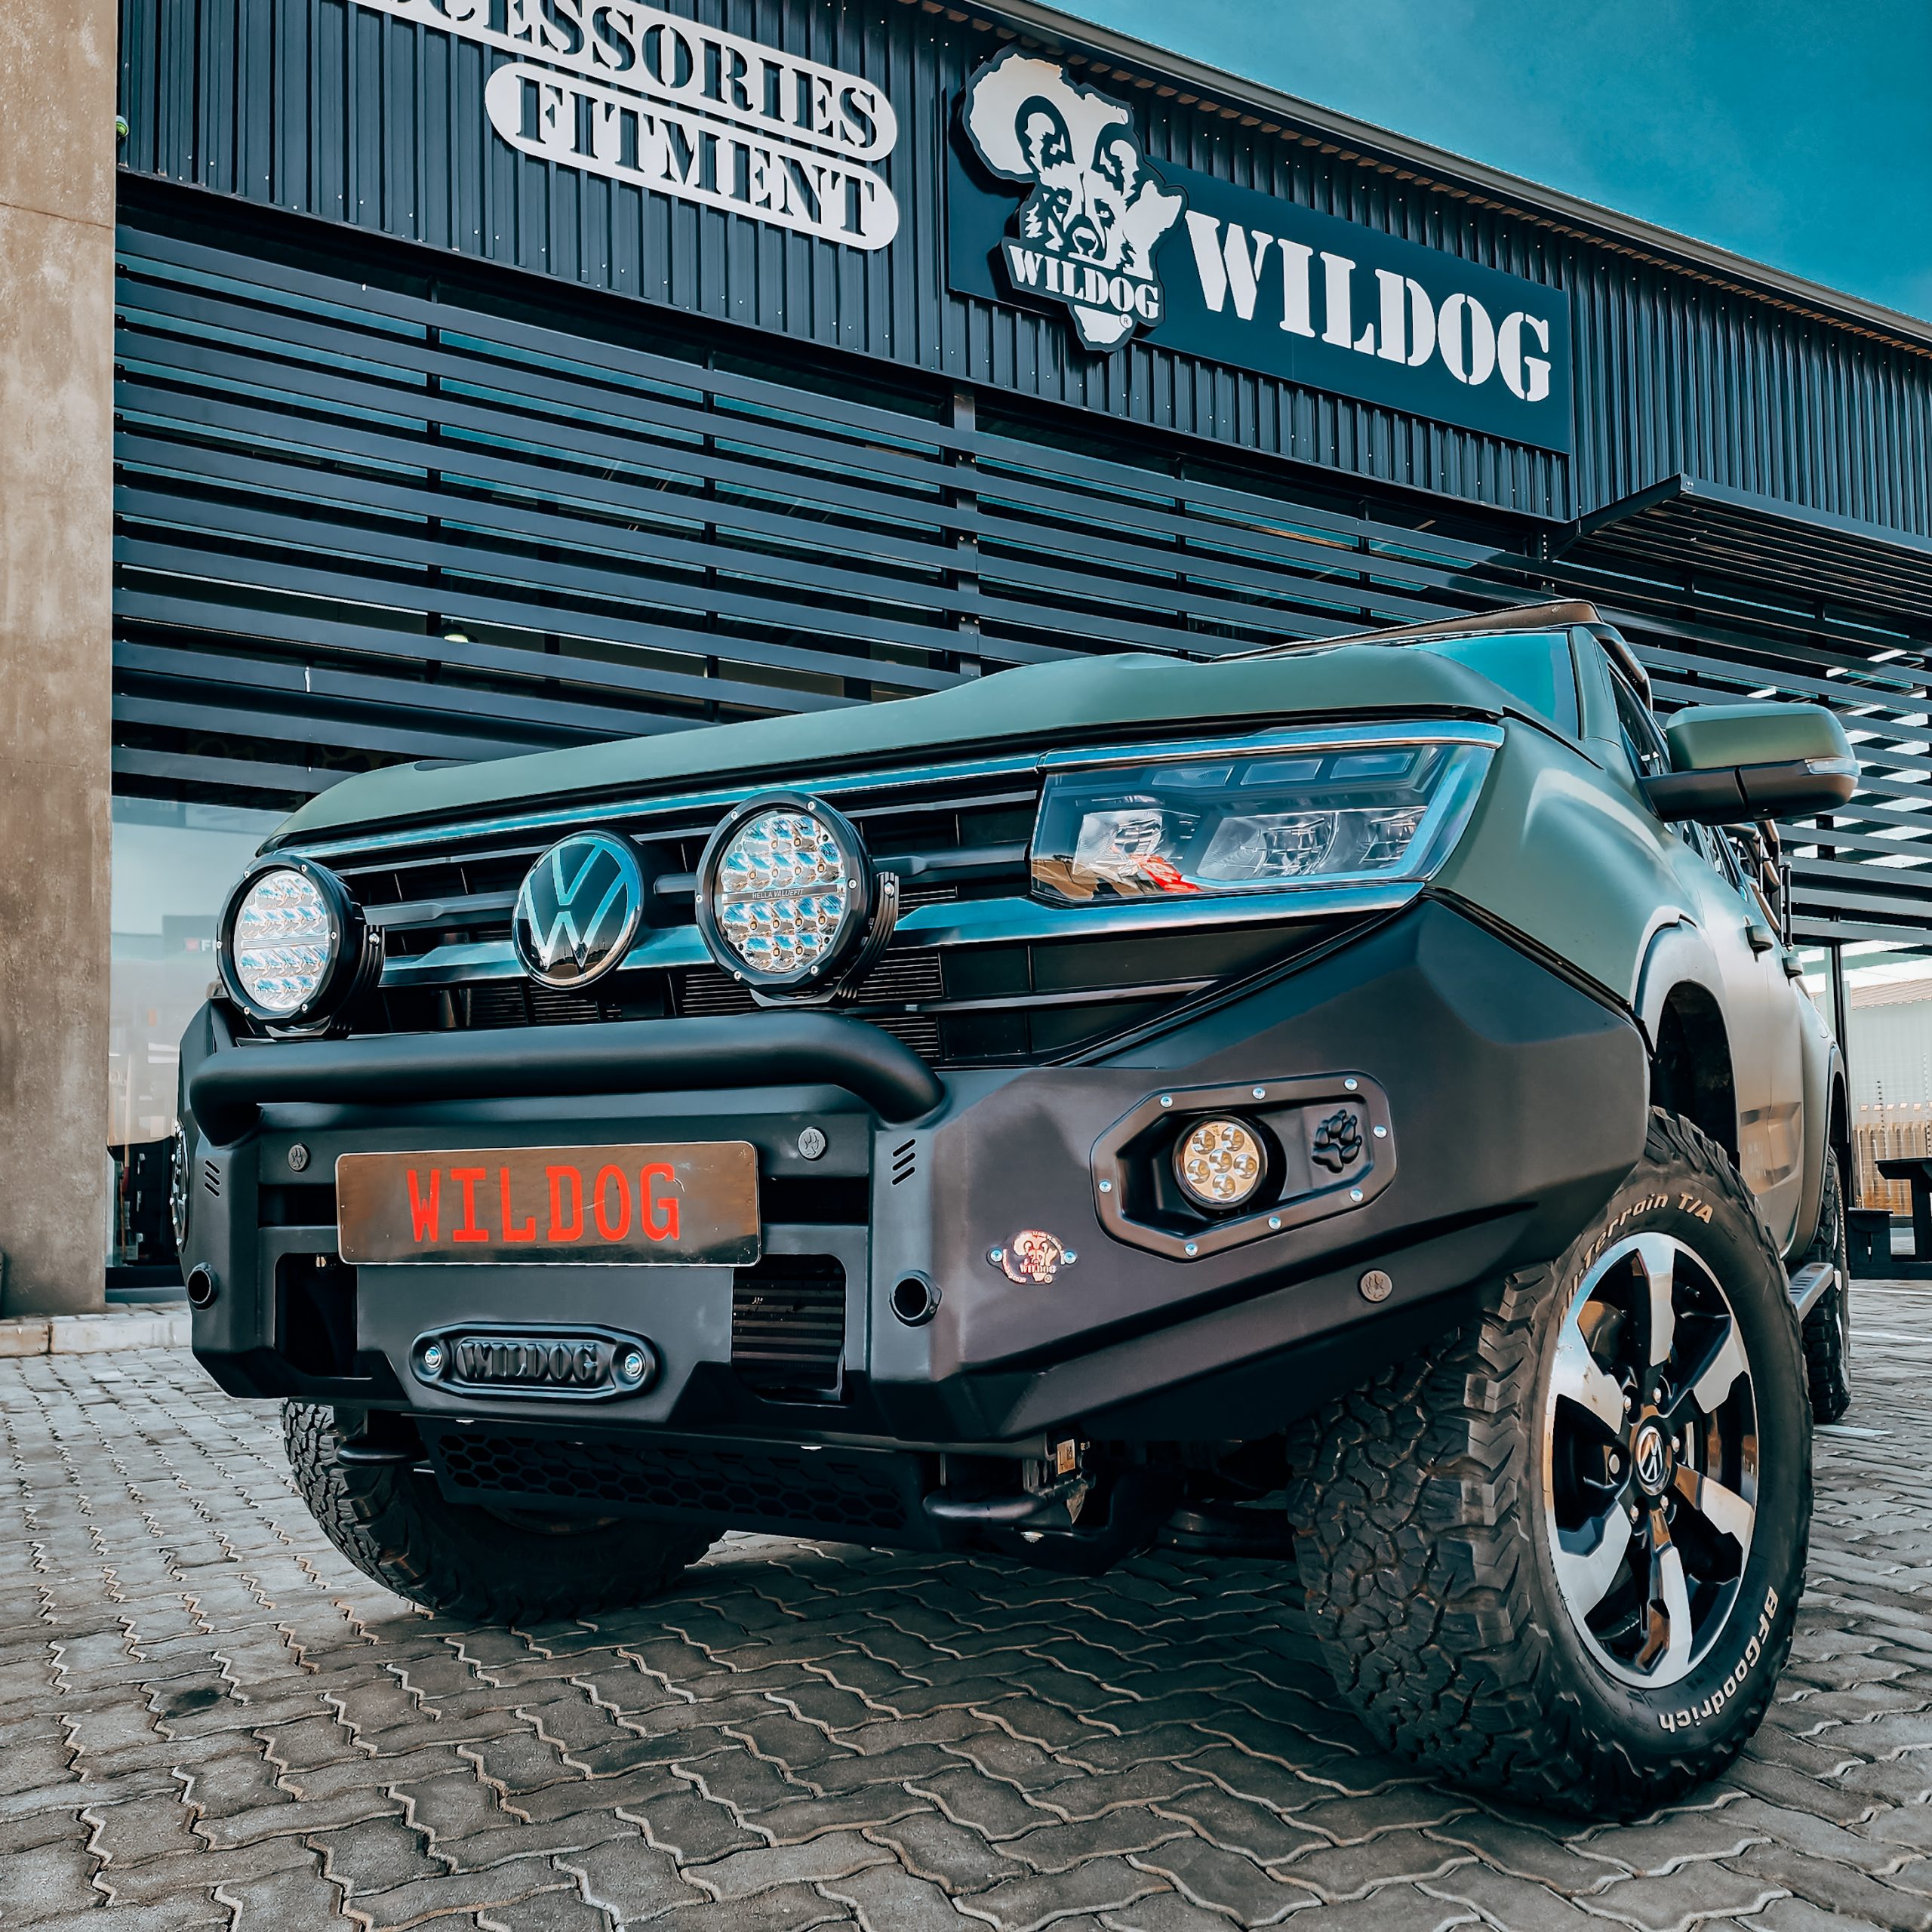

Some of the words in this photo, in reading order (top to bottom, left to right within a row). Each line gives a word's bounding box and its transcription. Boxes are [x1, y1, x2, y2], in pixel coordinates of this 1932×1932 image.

[391, 0, 878, 149] ESSORIES
[515, 74, 877, 237] FITMENT
[1008, 245, 1160, 319] WILDOG
[1185, 211, 1551, 402] WILDOG
[752, 891, 774, 899] HELLA
[773, 889, 804, 898] VALUEFIT
[407, 1162, 680, 1243] WILDOG
[1678, 1192, 1714, 1224] T/A
[457, 1341, 601, 1383] WILDOG
[1658, 1586, 1779, 1734] BFGoodrich
